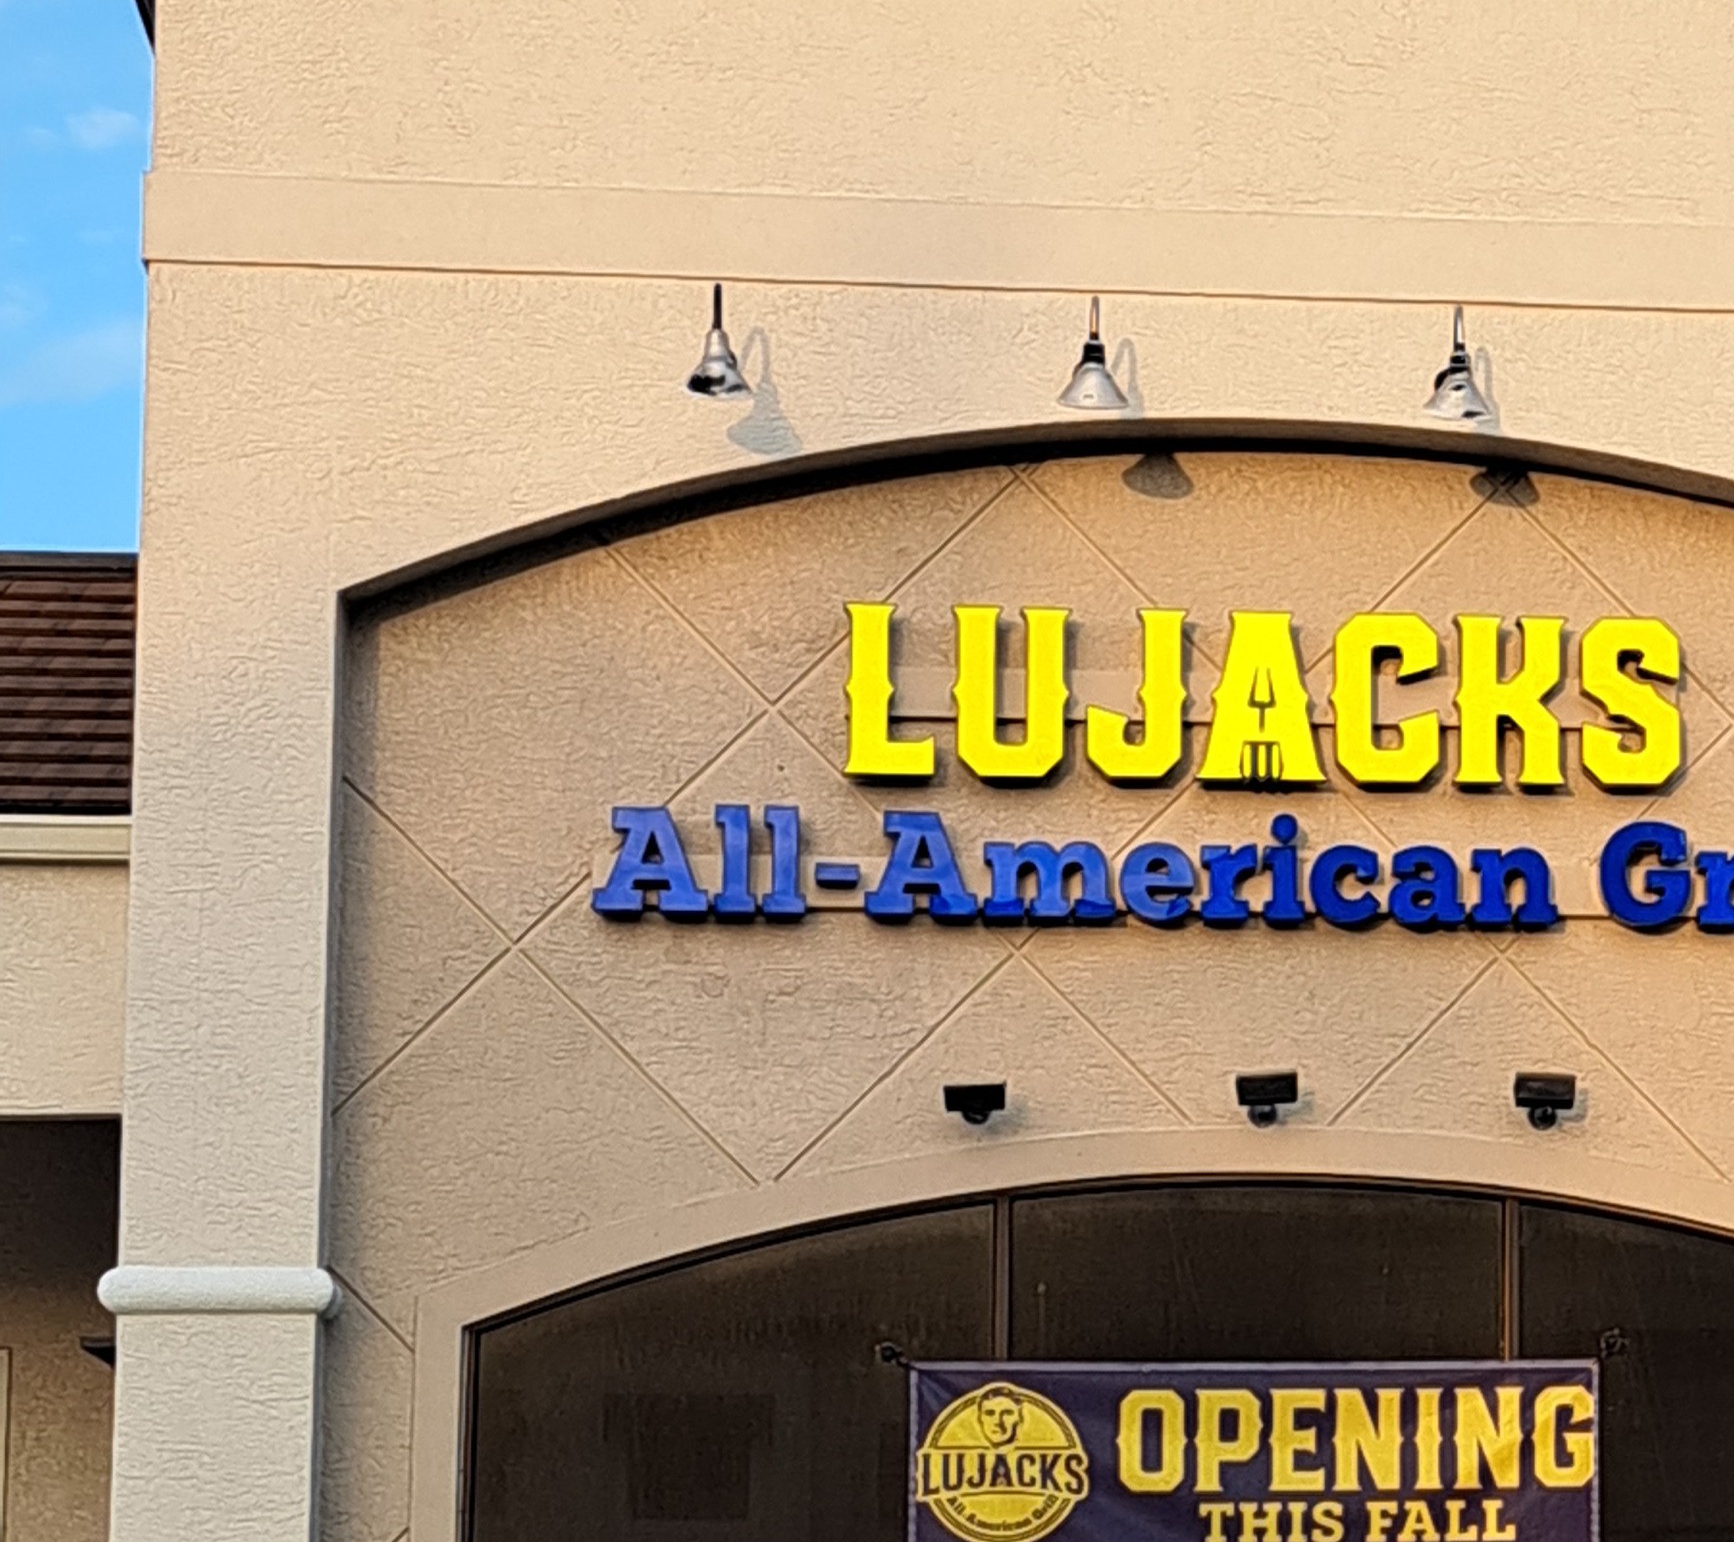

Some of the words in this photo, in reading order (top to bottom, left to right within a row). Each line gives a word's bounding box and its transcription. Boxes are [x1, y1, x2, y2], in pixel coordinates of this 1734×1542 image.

[842, 601, 1686, 789] LUJACKS
[592, 804, 1562, 931] All-American
[922, 1453, 1084, 1496] LUJACKS
[1117, 1385, 1595, 1493] OPENING
